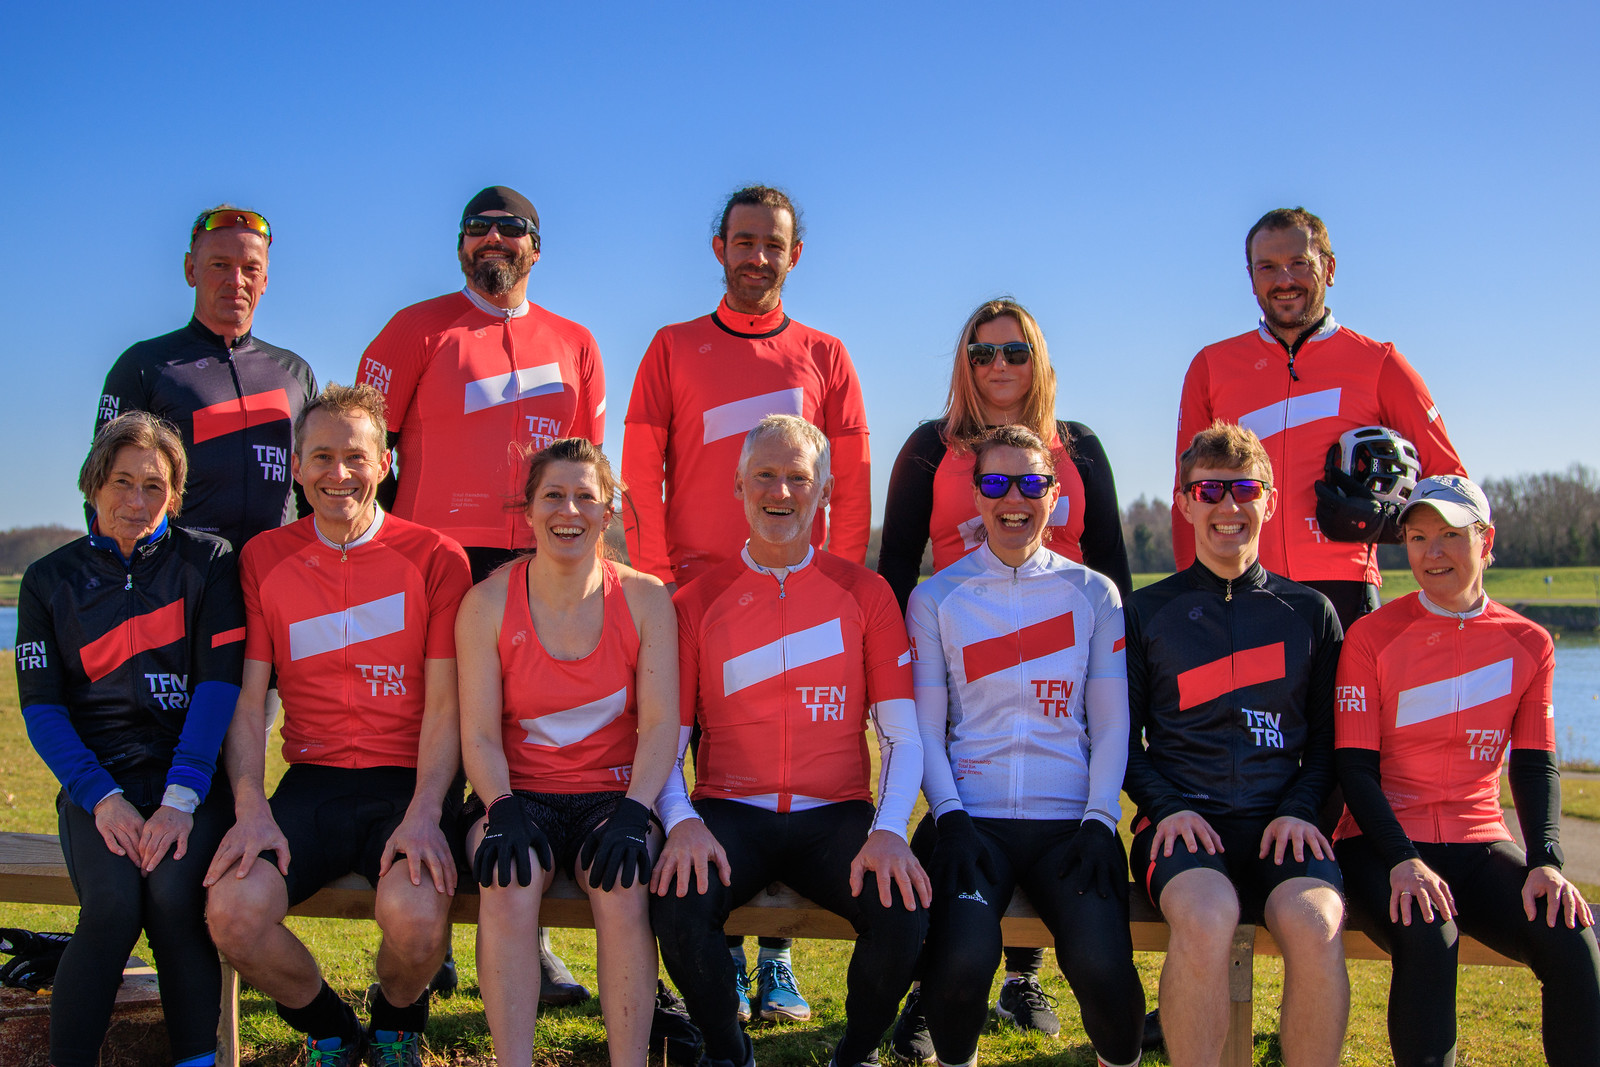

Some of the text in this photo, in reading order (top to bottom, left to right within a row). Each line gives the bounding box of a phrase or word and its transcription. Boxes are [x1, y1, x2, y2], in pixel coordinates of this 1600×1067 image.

[365, 357, 393, 382] TFN
[365, 371, 390, 395] TRI
[525, 415, 562, 436] TFN
[252, 444, 287, 465] TFN
[260, 462, 287, 482] TRI
[16, 640, 47, 659] TFN
[18, 654, 48, 671] TRI
[355, 664, 405, 681] TFN
[144, 673, 188, 693] TFN
[365, 679, 407, 697] TRI
[1030, 679, 1074, 699] TFN
[1336, 685, 1366, 699] TFN
[153, 692, 190, 711] TRI
[795, 685, 847, 704] TFN
[805, 703, 845, 722] TRI
[1337, 698, 1367, 712] TRI
[1241, 707, 1282, 731] TFN
[1250, 727, 1284, 749] TRI
[1465, 728, 1506, 746] TFN
[1467, 744, 1500, 762] TRI
[608, 765, 633, 781] TF
